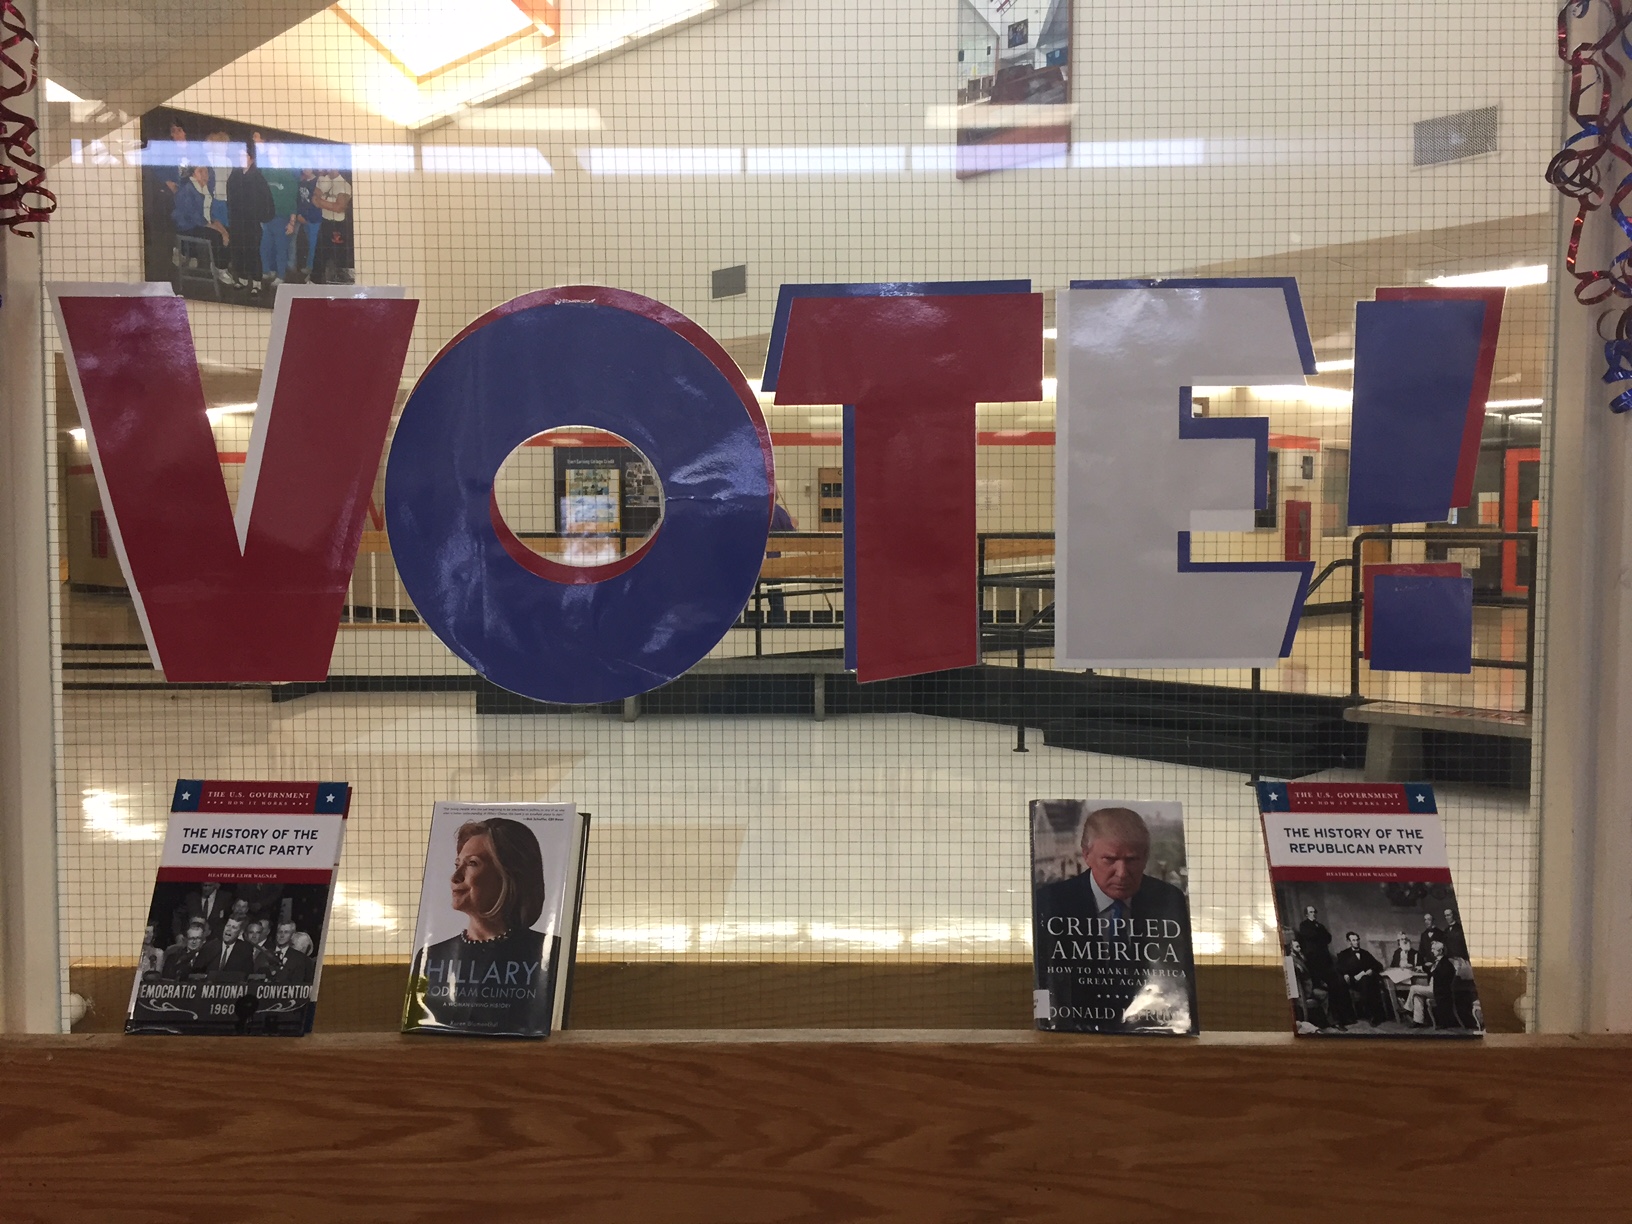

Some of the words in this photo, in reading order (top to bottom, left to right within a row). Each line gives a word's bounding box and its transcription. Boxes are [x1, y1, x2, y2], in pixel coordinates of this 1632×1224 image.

[47, 277, 1506, 706] VOTE!
[183, 828, 208, 838] THE
[212, 828, 268, 840] HISTORY
[272, 829, 290, 840] OF
[294, 830, 319, 840] THE
[1284, 828, 1310, 838] THE
[1314, 828, 1370, 839] HISTORY
[1376, 829, 1392, 839] OF
[1397, 829, 1424, 839] THE
[182, 844, 266, 855] DEMOCRATIC
[269, 844, 314, 856] PARTY
[1290, 843, 1376, 854] REPUBLICAN
[1379, 844, 1423, 854] PARTY
[1047, 916, 1181, 939] CRIPPLED
[1051, 940, 1180, 963] AMERICA
[426, 959, 539, 985] HILLARY
[1097, 968, 1129, 976] MAKE
[1134, 968, 1186, 978] AMERICA
[1078, 978, 1115, 986] GREAT
[1119, 978, 1153, 987] AGAI
[138, 984, 197, 999] EMOCRATIC
[481, 986, 537, 1000] CLINTON
[210, 1004, 235, 1015] 1960
[1048, 1006, 1116, 1020] DONALD
